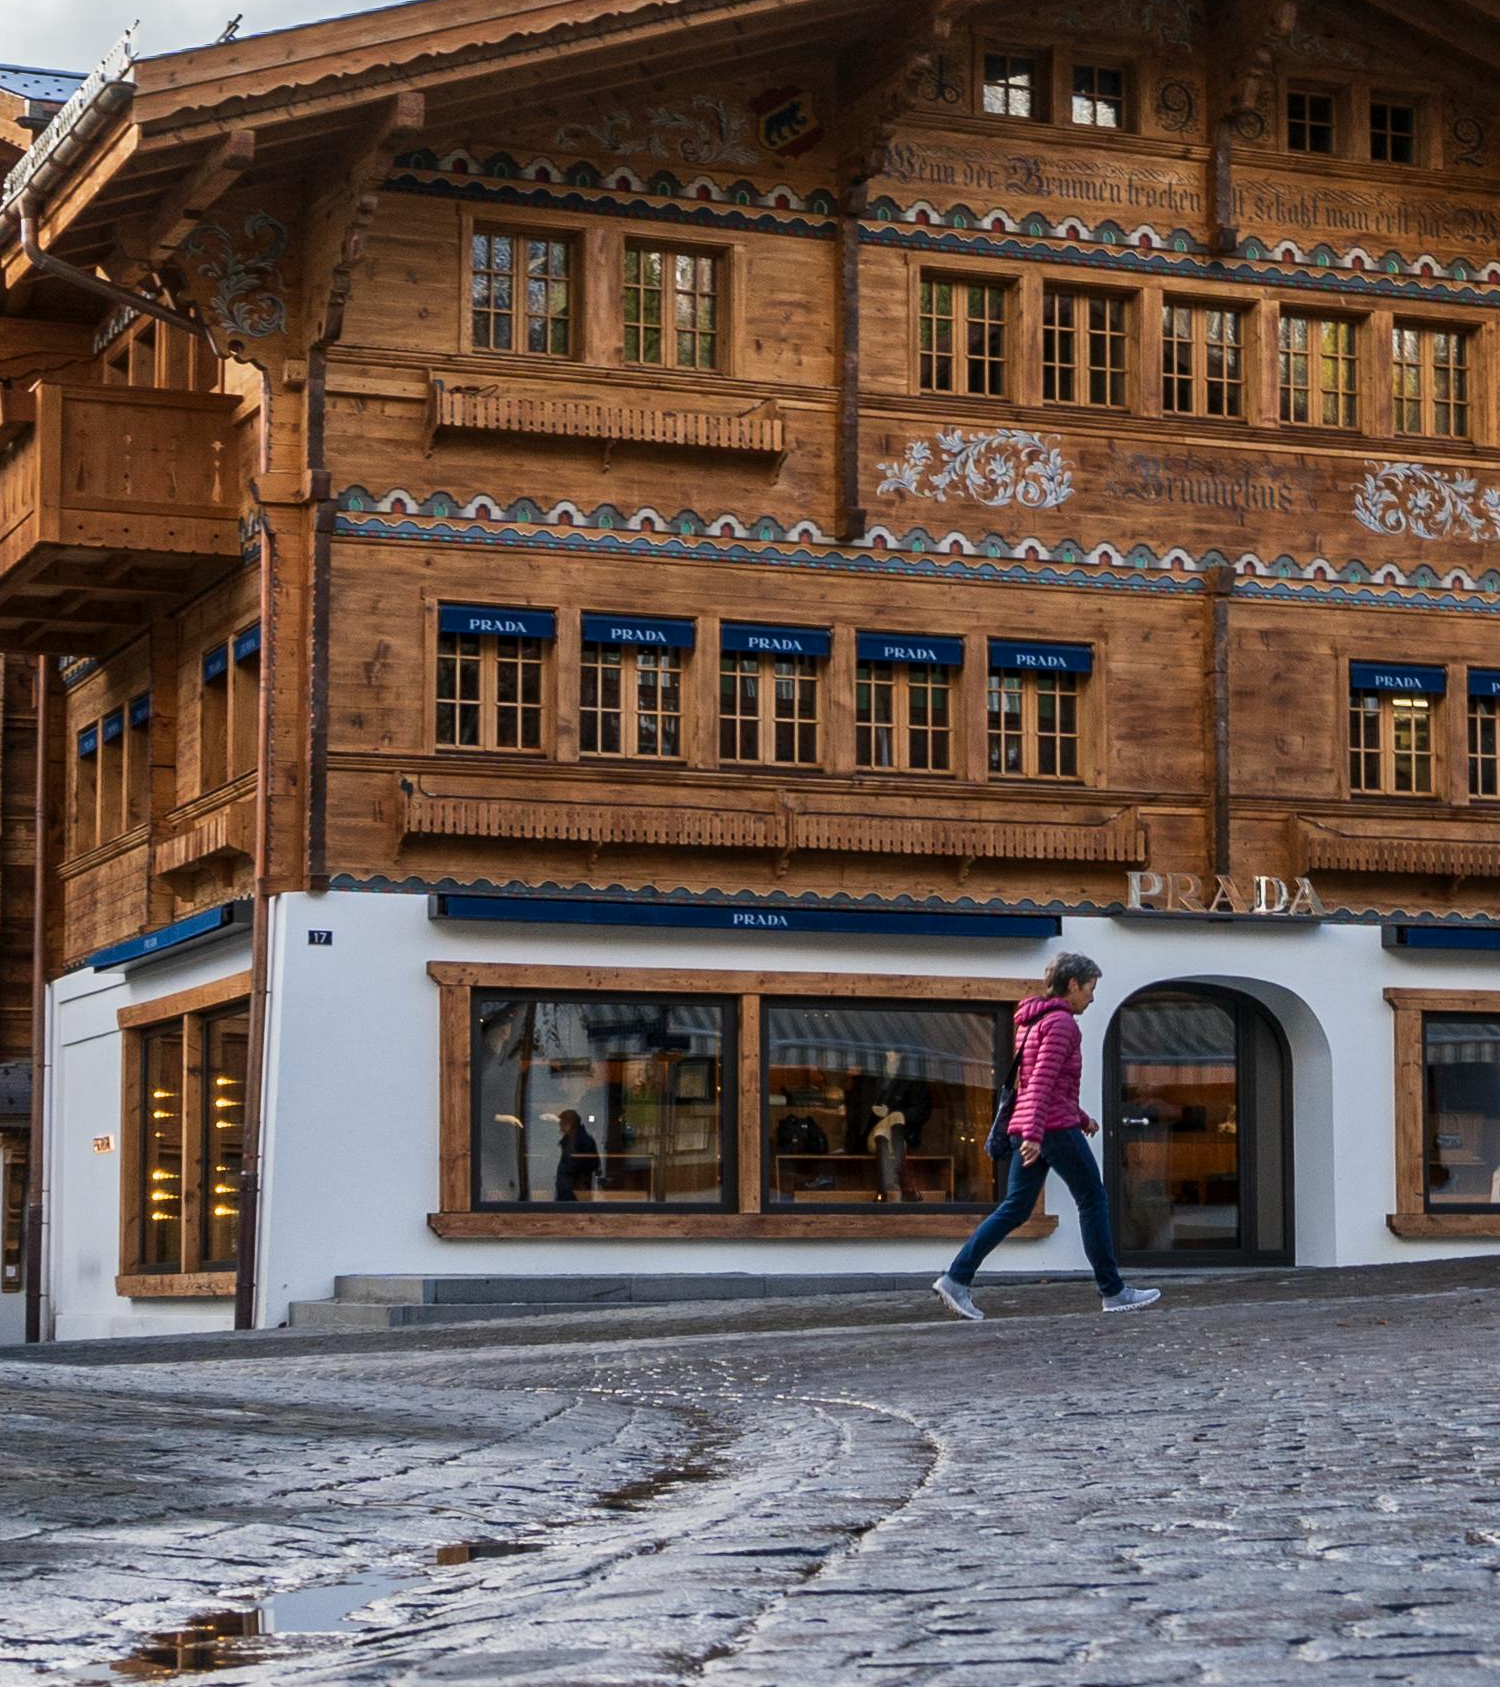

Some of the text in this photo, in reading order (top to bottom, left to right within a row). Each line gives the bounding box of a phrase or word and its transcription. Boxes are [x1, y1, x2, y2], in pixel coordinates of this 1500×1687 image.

[469, 618, 528, 633] PRADA
[611, 628, 667, 642] PRADA
[748, 636, 803, 651] PRADA
[884, 646, 937, 661] PRADA
[1016, 654, 1067, 668] PRADA
[1375, 675, 1423, 689] PRADA
[1126, 871, 1326, 916] PRADA
[733, 913, 788, 926] PRADA
[312, 932, 328, 944] 17
